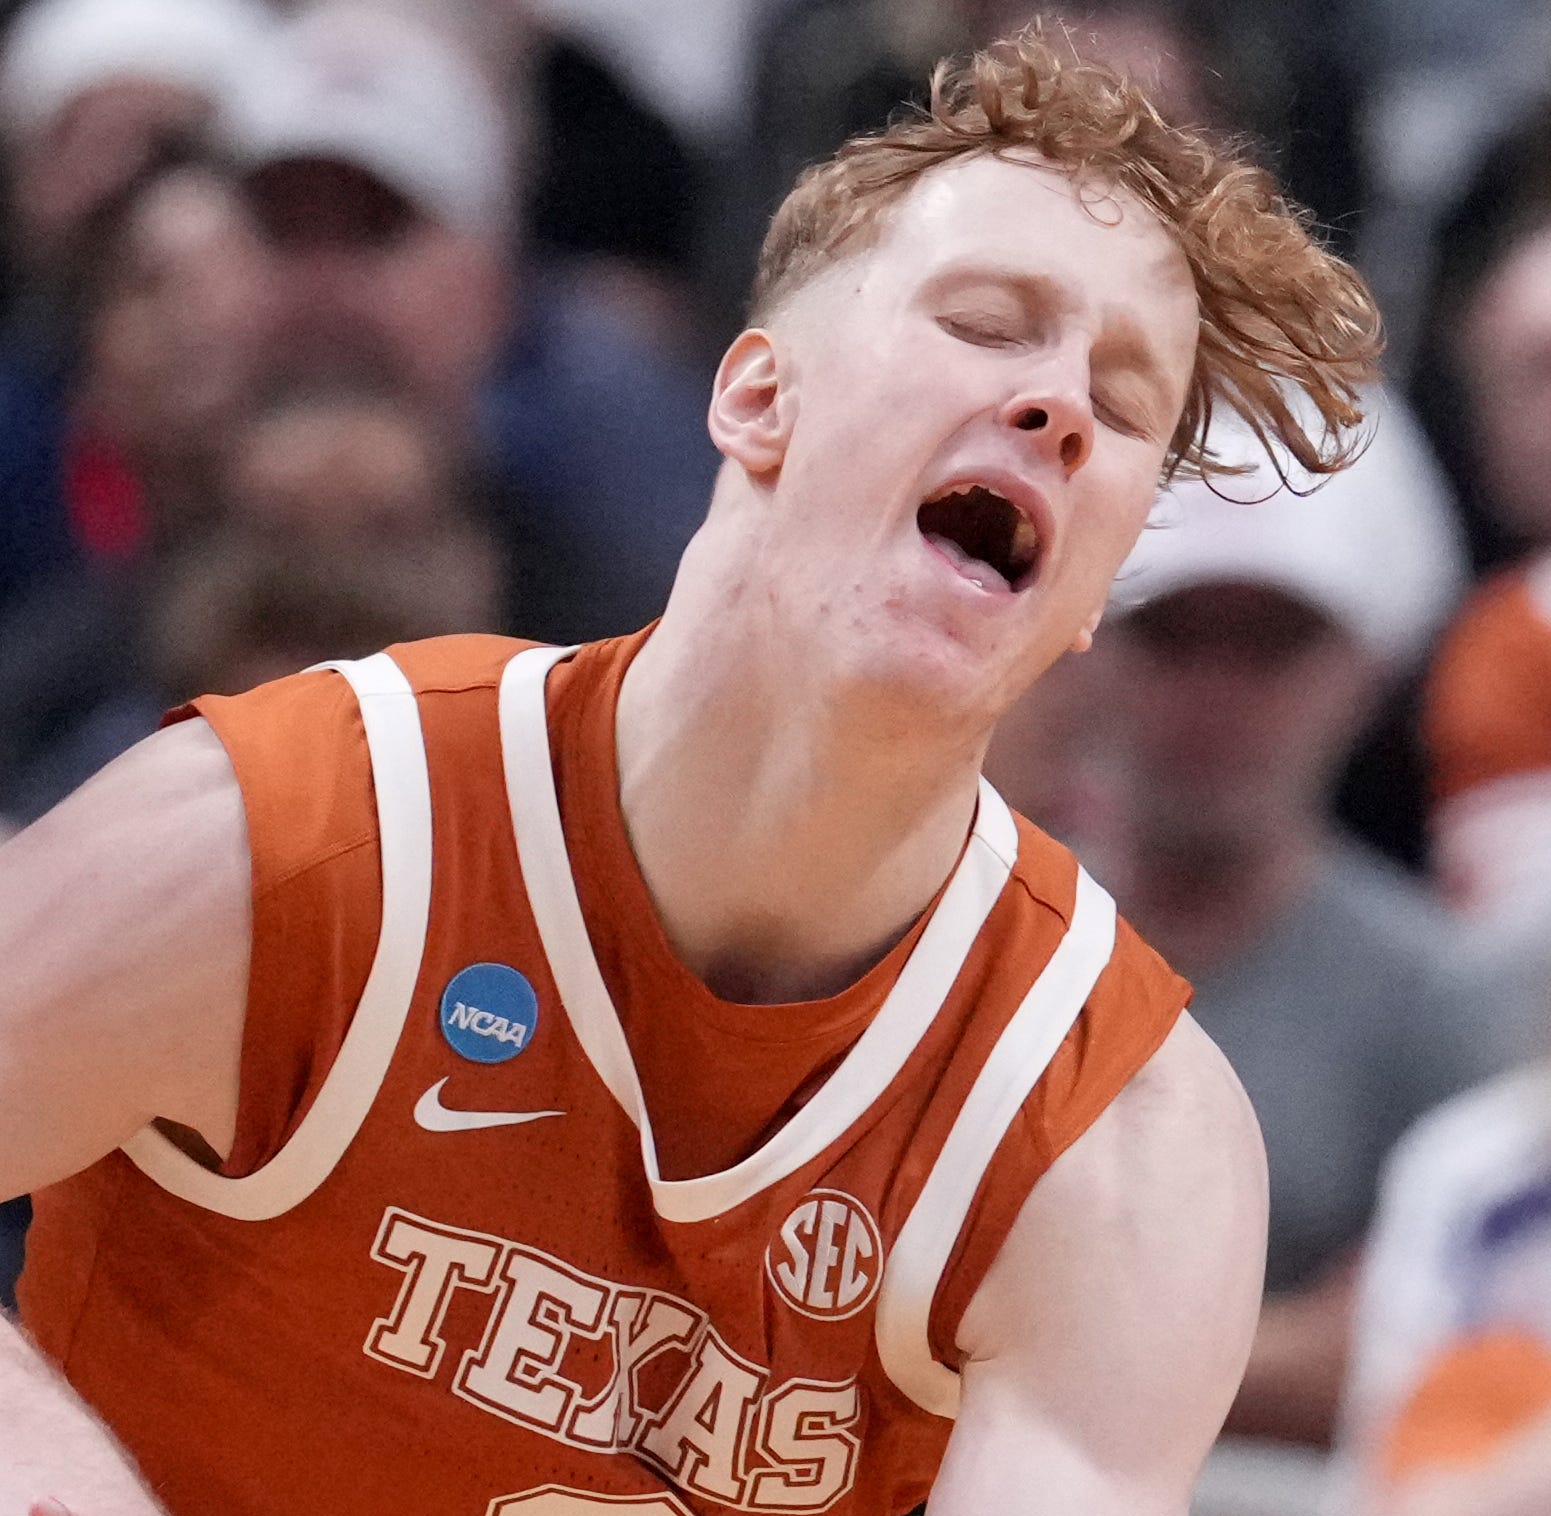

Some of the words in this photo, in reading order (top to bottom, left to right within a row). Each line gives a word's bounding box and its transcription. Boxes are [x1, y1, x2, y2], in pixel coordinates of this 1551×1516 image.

[448, 1001, 528, 1048] NCAA
[776, 1199, 873, 1309] SEC
[362, 1206, 861, 1514] TEXAS
